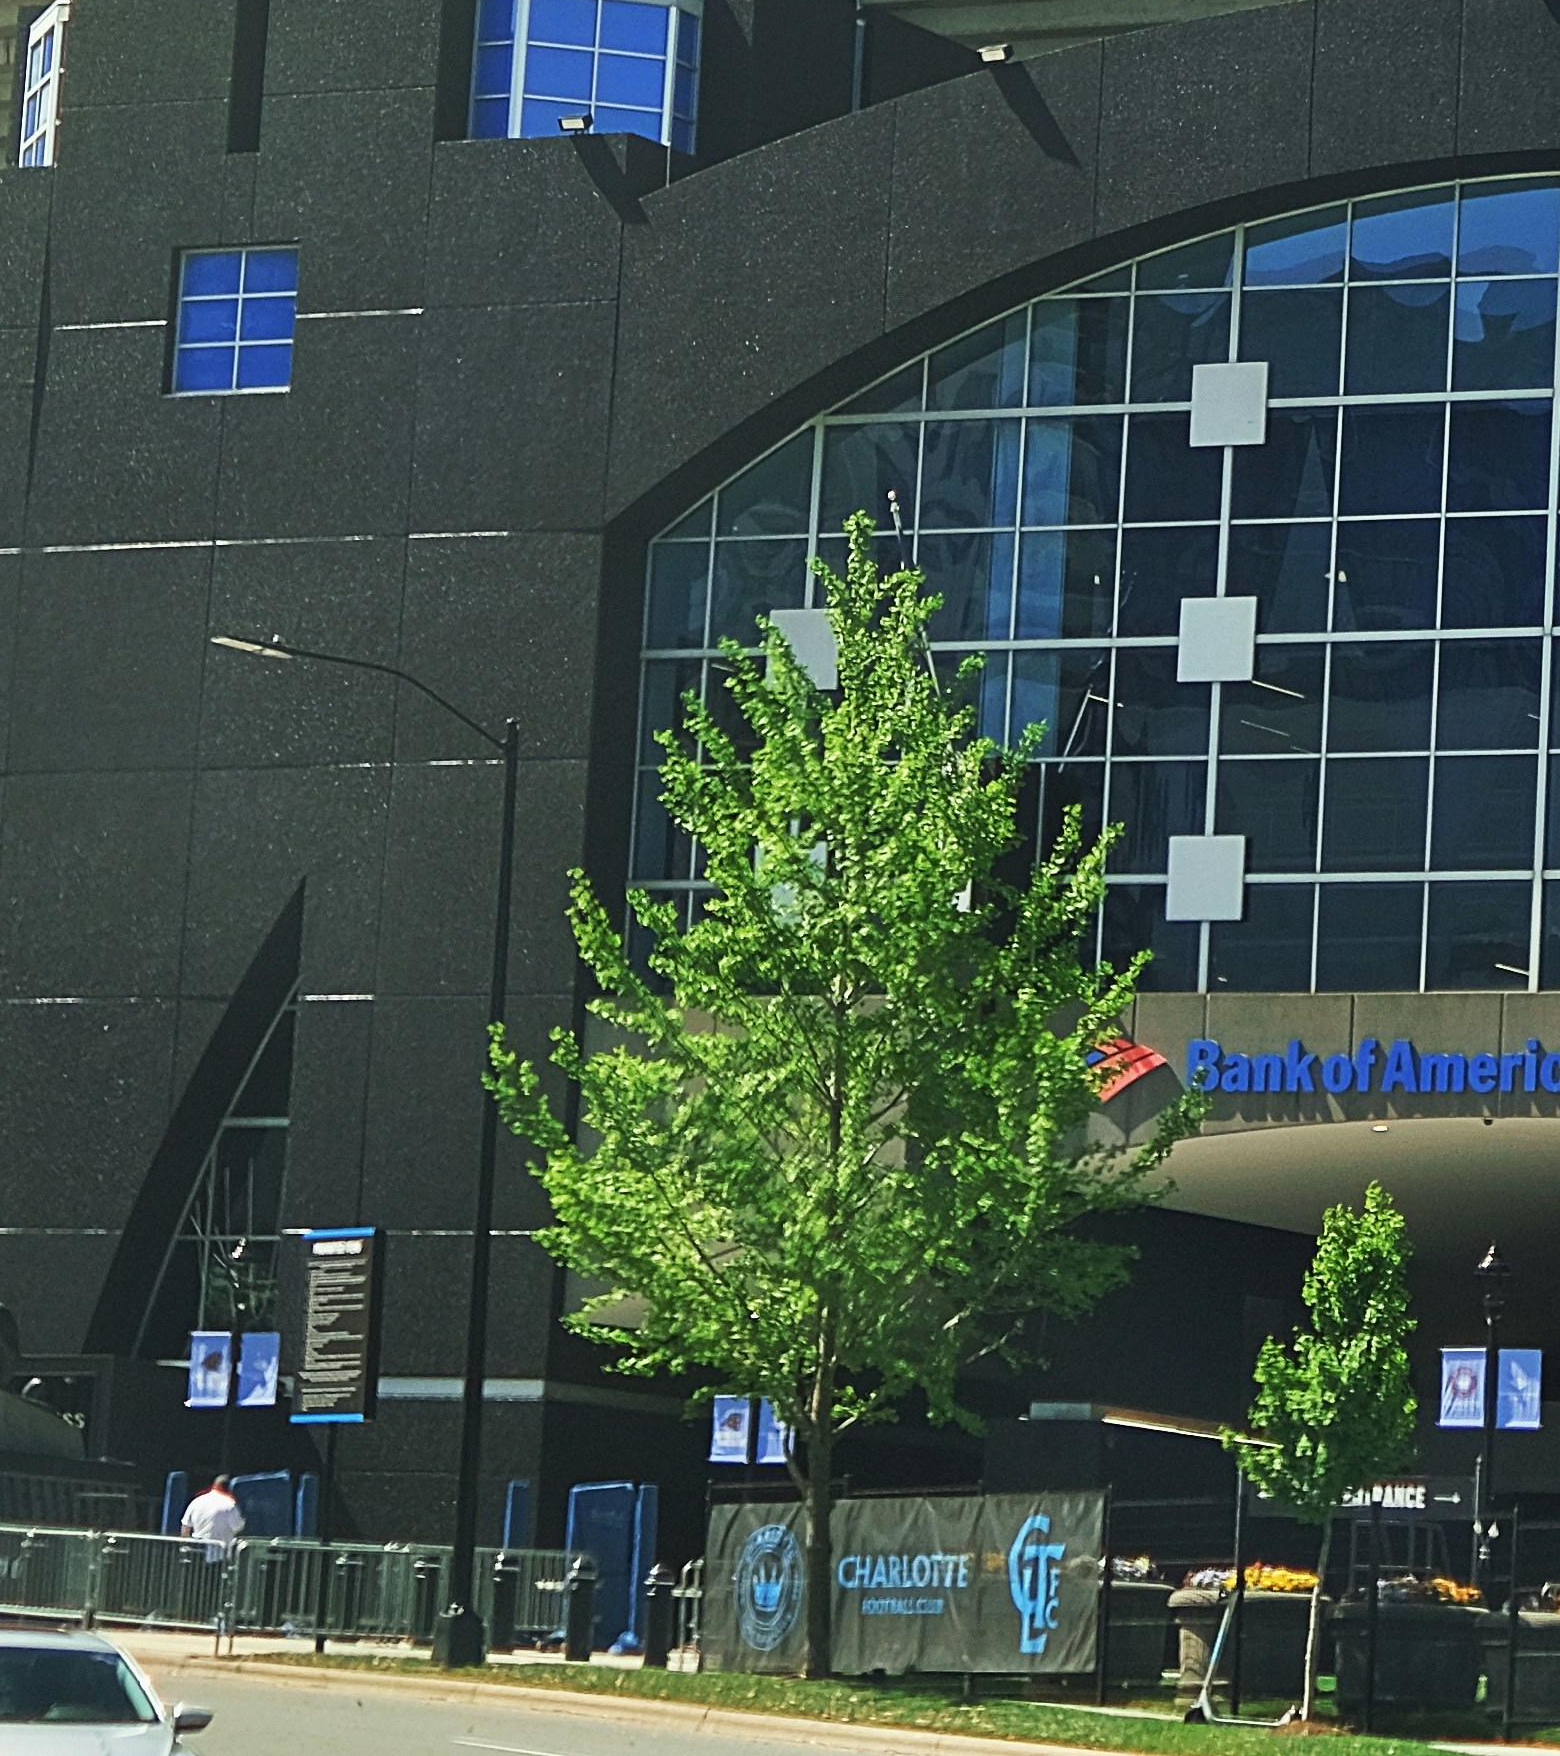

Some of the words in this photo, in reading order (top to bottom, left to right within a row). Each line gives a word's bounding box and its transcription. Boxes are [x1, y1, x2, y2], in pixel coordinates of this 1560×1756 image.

[1187, 1038, 1320, 1094] Bank
[1322, 1038, 1377, 1094] of
[838, 1554, 969, 1589] CHARLOTTE
